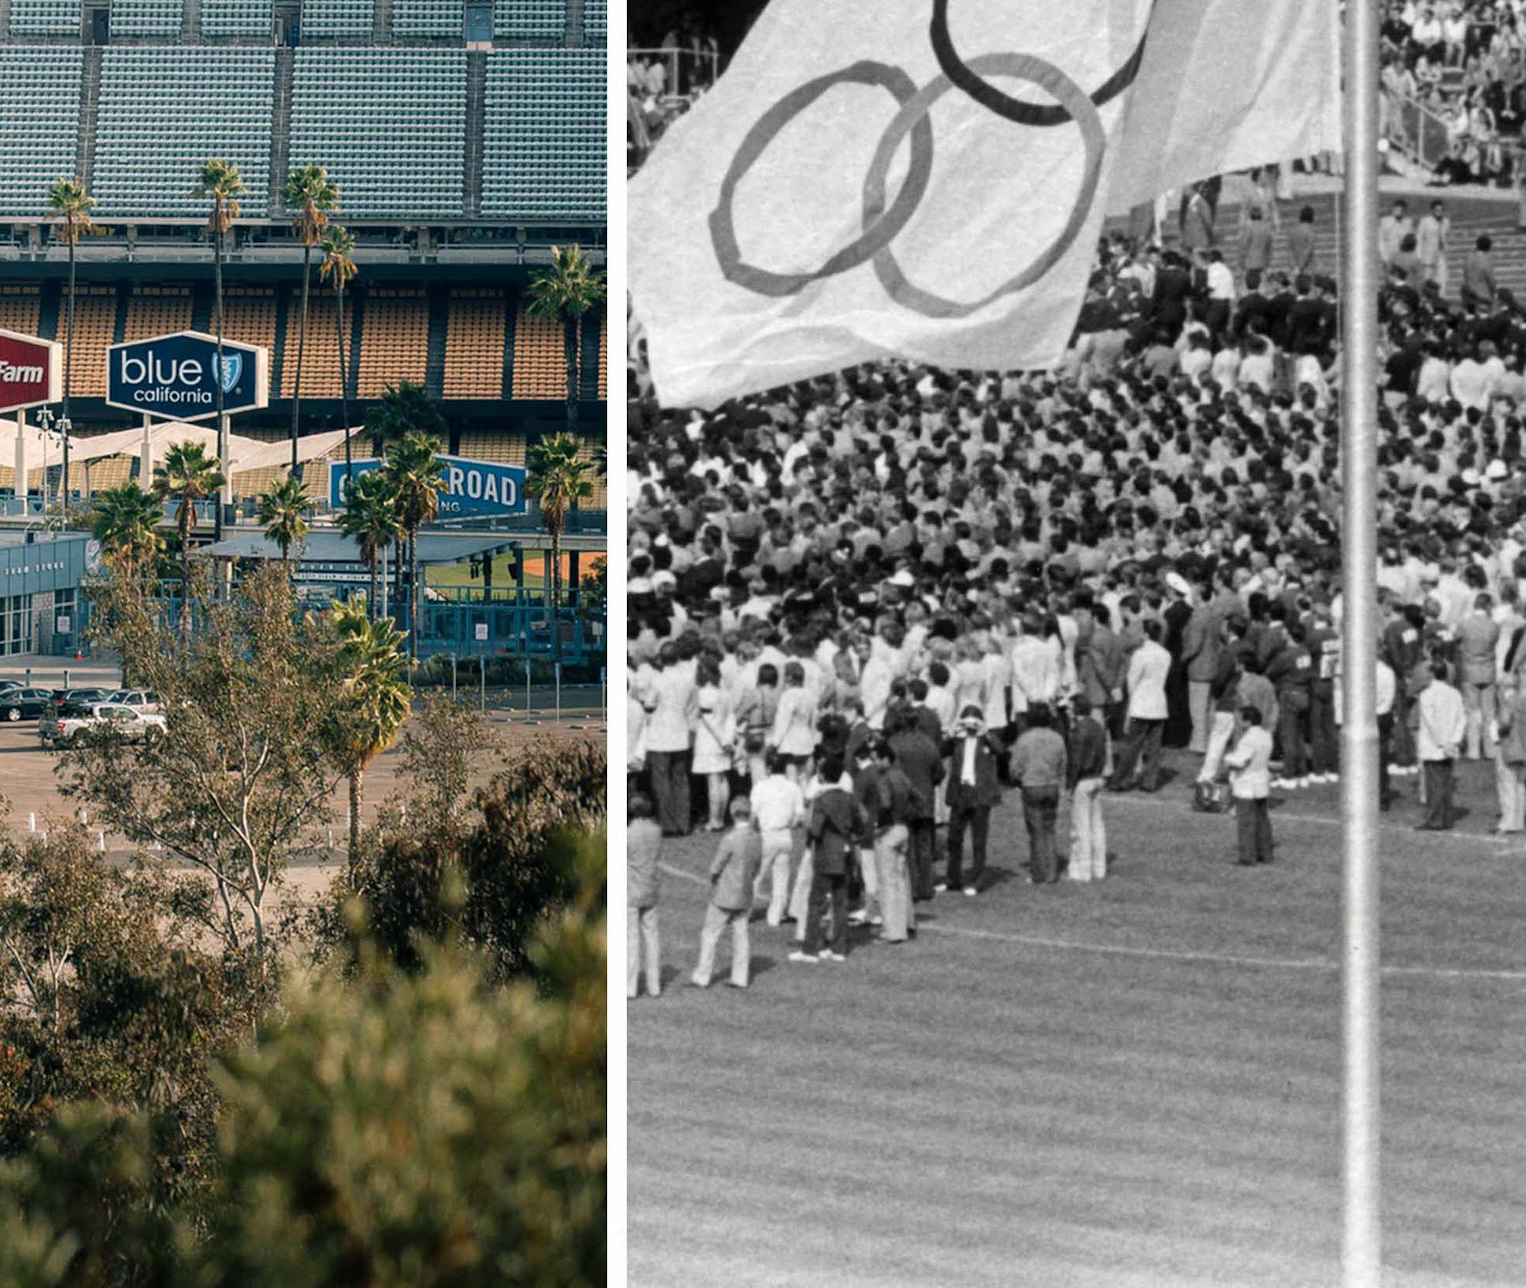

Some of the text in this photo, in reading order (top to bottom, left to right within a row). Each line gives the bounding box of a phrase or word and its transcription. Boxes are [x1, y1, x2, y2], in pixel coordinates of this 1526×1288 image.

[121, 350, 203, 385] blue
[134, 387, 213, 404] california
[450, 466, 517, 506] ROAD
